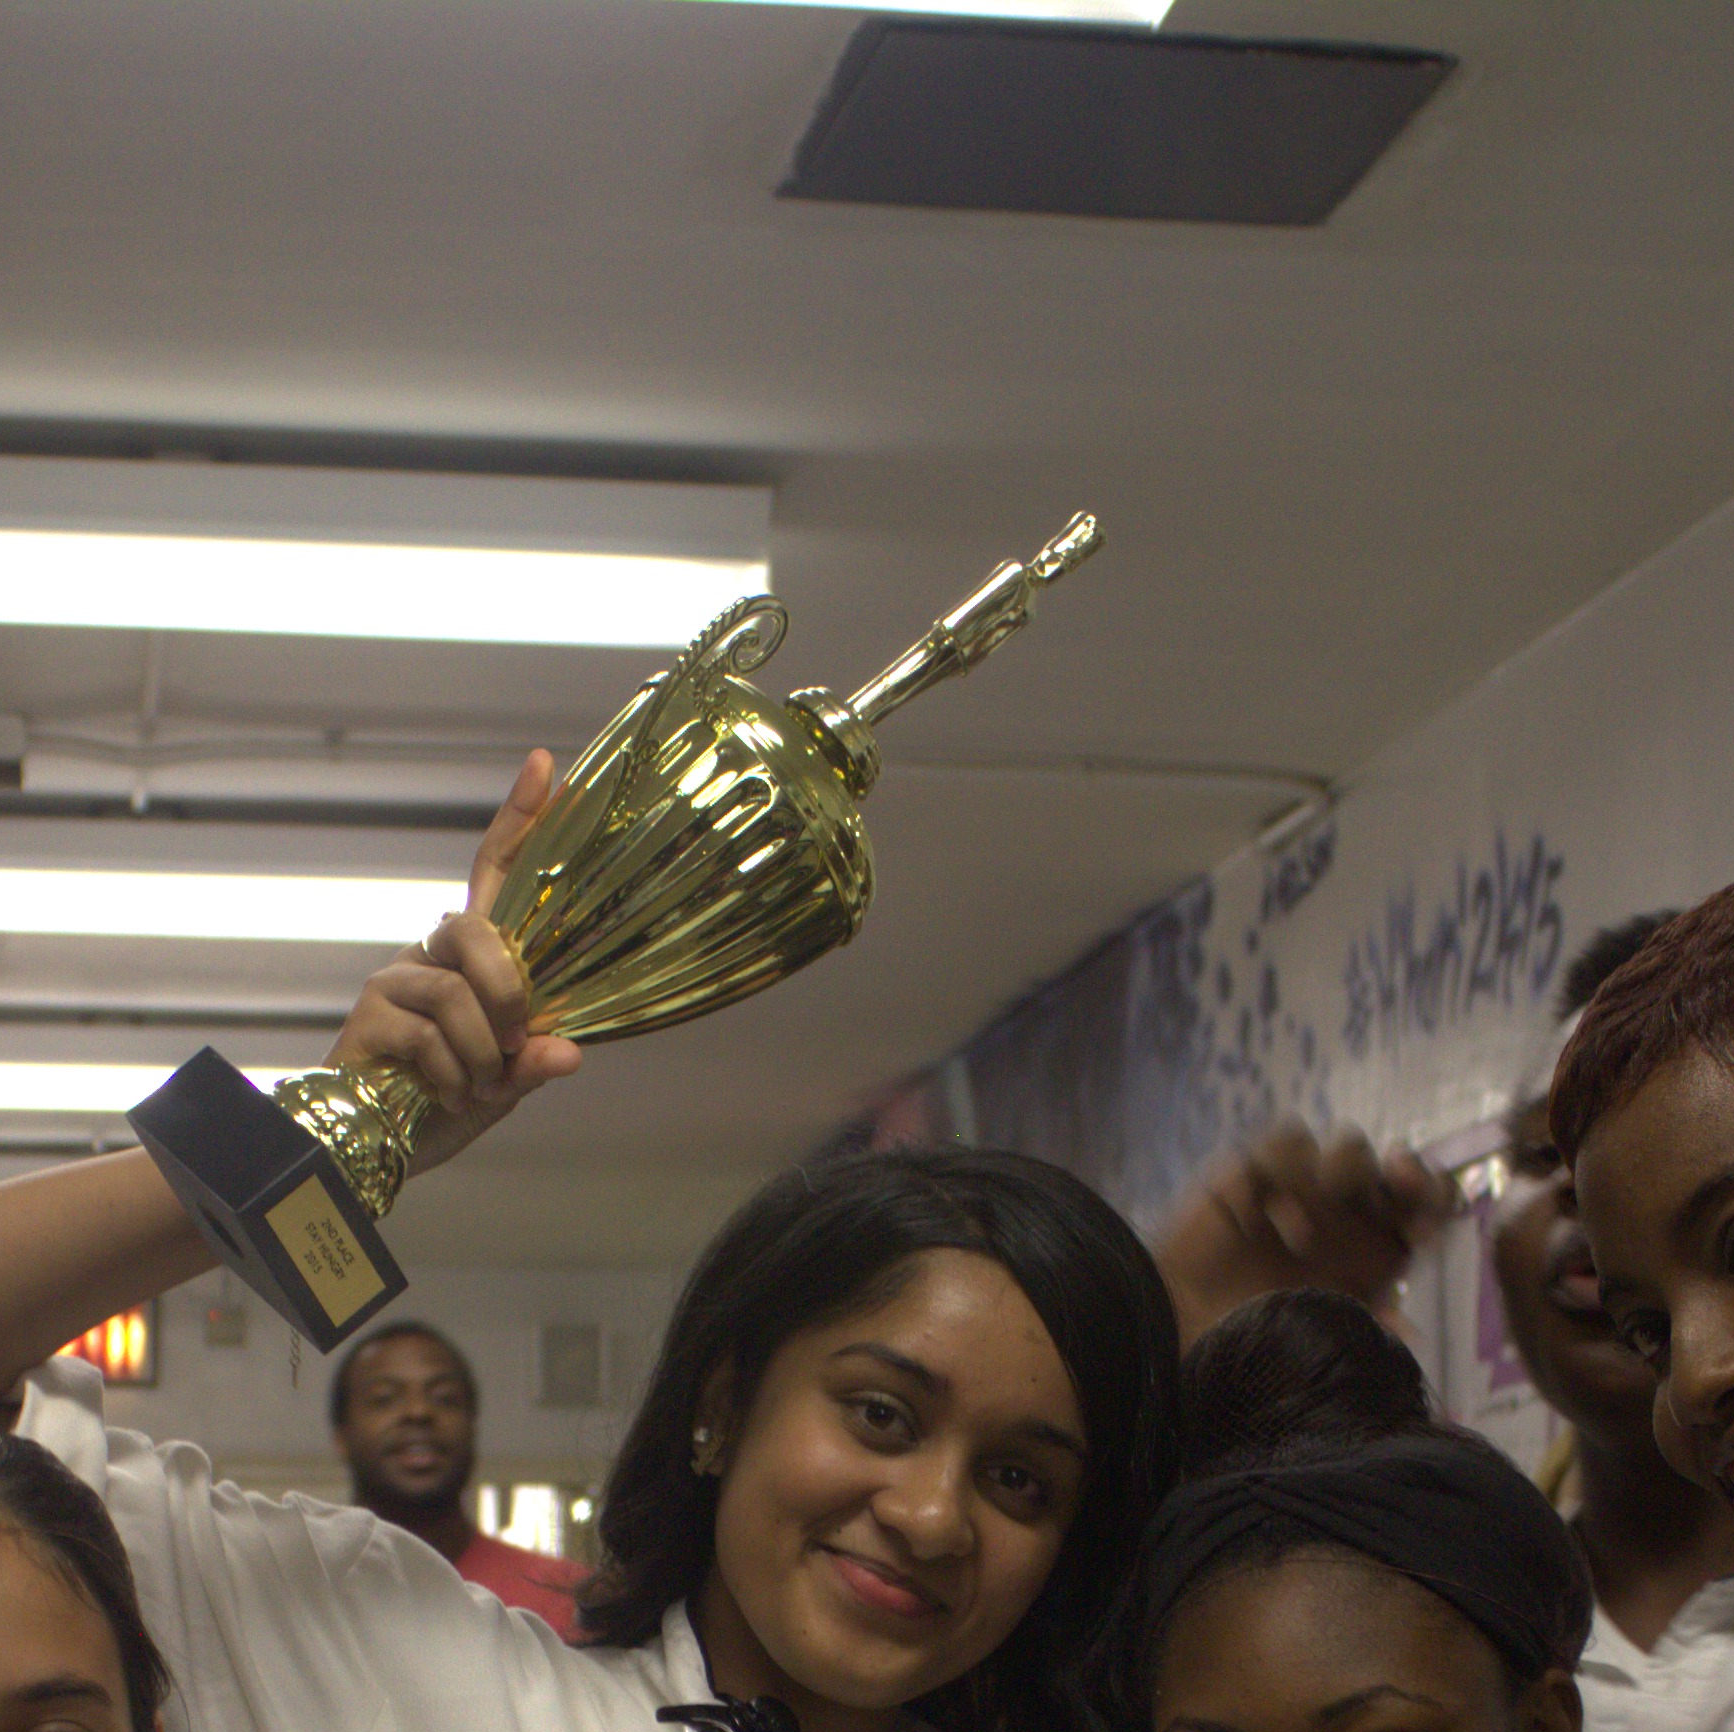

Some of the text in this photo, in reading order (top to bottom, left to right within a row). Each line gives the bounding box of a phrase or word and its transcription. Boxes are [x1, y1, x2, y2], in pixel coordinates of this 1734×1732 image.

[305, 1221, 346, 1281] STAY HUNGRY
[321, 1217, 356, 1268] 2ND PLACE
